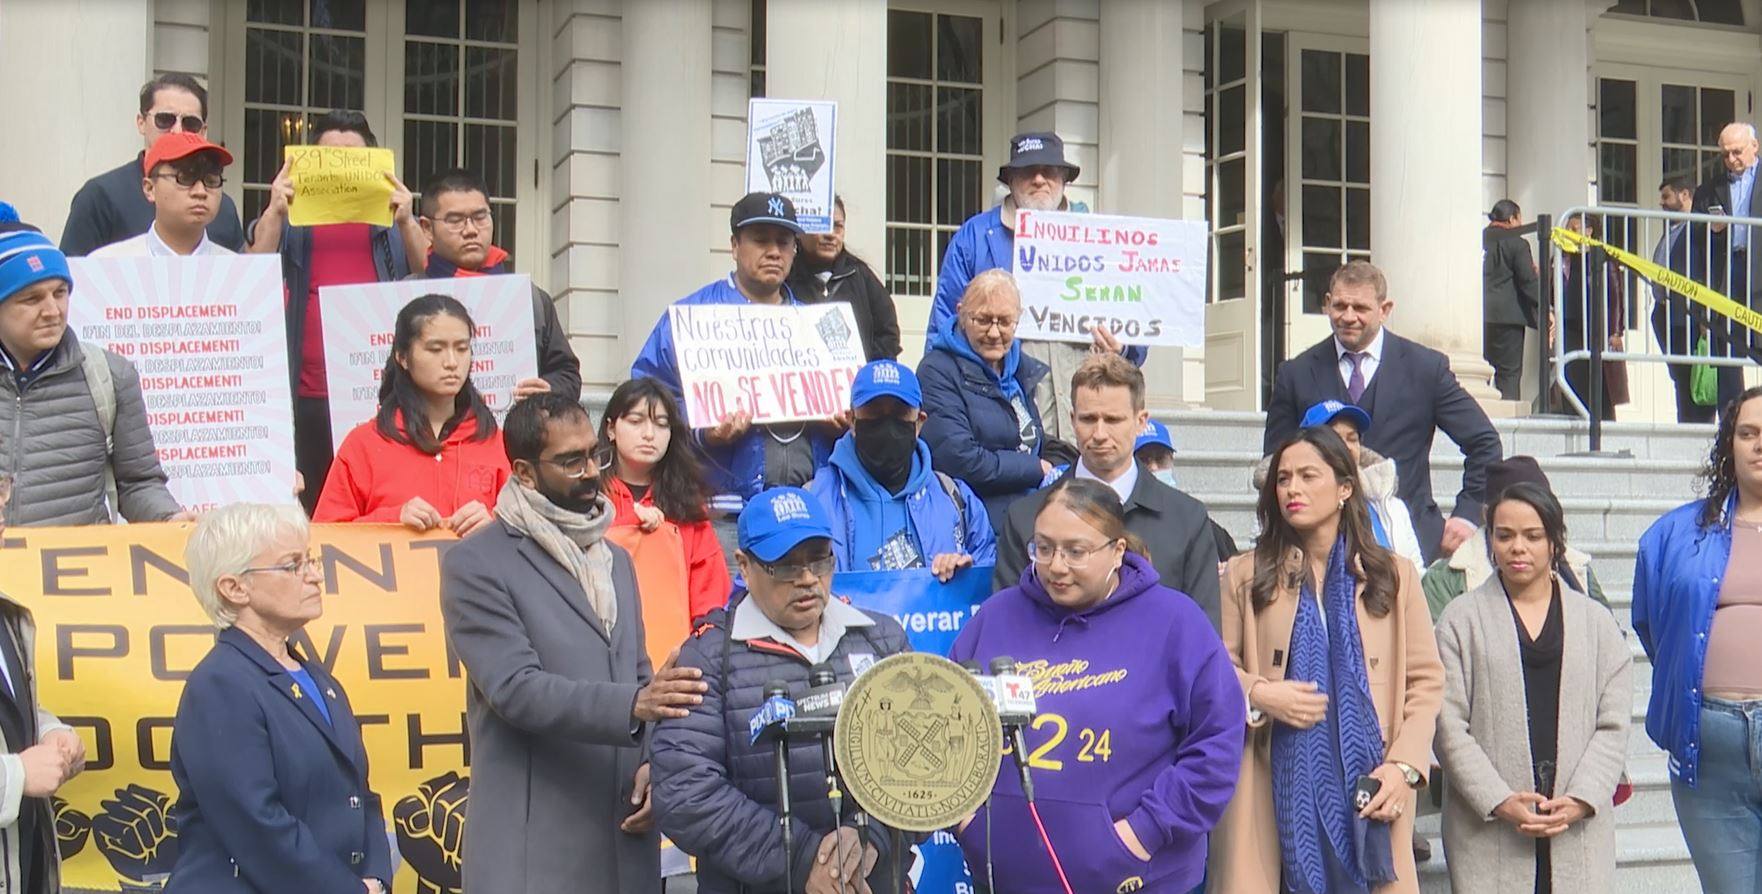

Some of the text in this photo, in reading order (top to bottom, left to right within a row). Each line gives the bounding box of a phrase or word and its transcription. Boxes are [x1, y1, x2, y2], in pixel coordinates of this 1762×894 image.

[1016, 212, 1158, 246] INQUILINOS
[1019, 246, 1181, 273] UNIDOS JAMAS
[1656, 269, 1698, 298] CAUTION
[106, 307, 132, 320] END
[1029, 306, 1162, 337] VENCIDOS
[115, 323, 140, 338] DEL
[683, 336, 820, 372] comunidades
[692, 377, 727, 424] NO
[735, 374, 770, 421] SE
[803, 699, 829, 712] NEWS
[1019, 690, 1030, 700] 47
[1077, 728, 1111, 763] 24
[906, 790, 934, 800] 1625
[939, 783, 974, 814] NOVI
